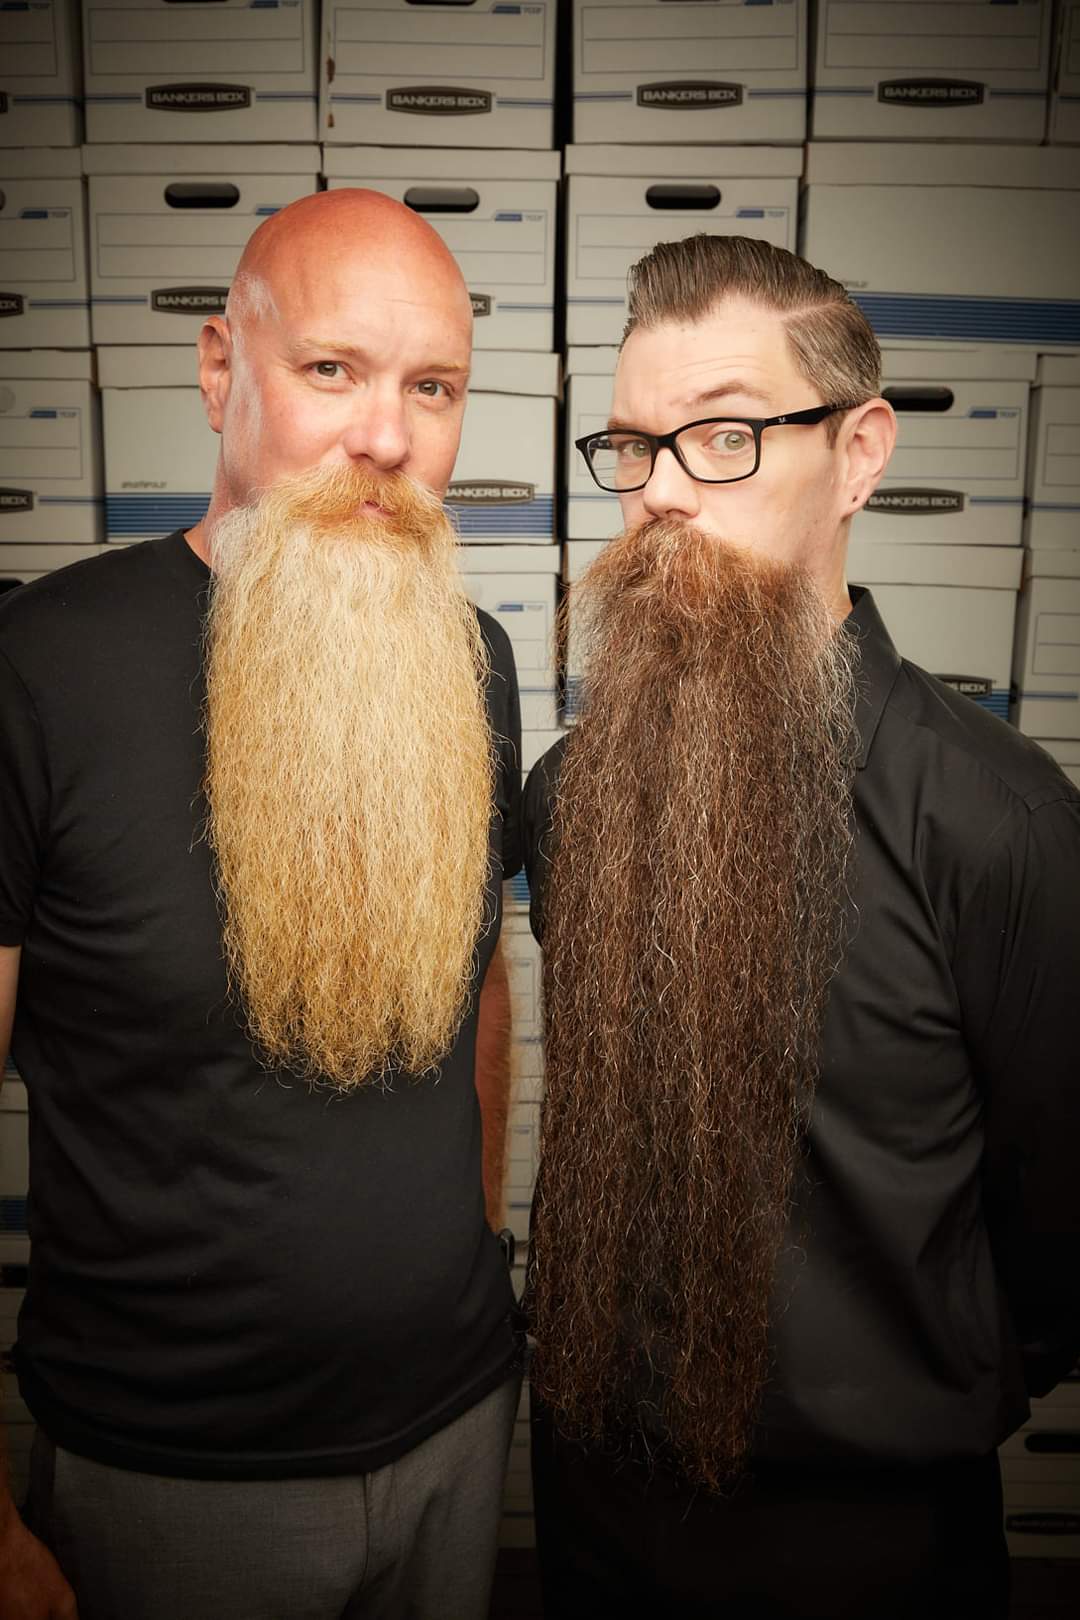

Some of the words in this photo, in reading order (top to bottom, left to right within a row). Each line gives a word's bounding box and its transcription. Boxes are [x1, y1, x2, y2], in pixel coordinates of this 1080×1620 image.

[151, 92, 215, 104] BANKERS
[216, 92, 245, 103] BOX
[642, 90, 707, 101] BANKERS
[708, 90, 737, 101] BOX
[884, 87, 949, 98] BANKERS
[950, 87, 978, 98] BOX
[392, 95, 456, 106] BANKERS
[457, 96, 486, 107] BOX
[0, 300, 18, 310] OX
[157, 295, 220, 306] BANKERS
[446, 487, 501, 498] ANKERS
[502, 487, 530, 498] BOX
[0, 495, 28, 506] BOX
[868, 496, 930, 507] BANKERS
[931, 496, 958, 507] BOX
[959, 682, 986, 693] BOX
